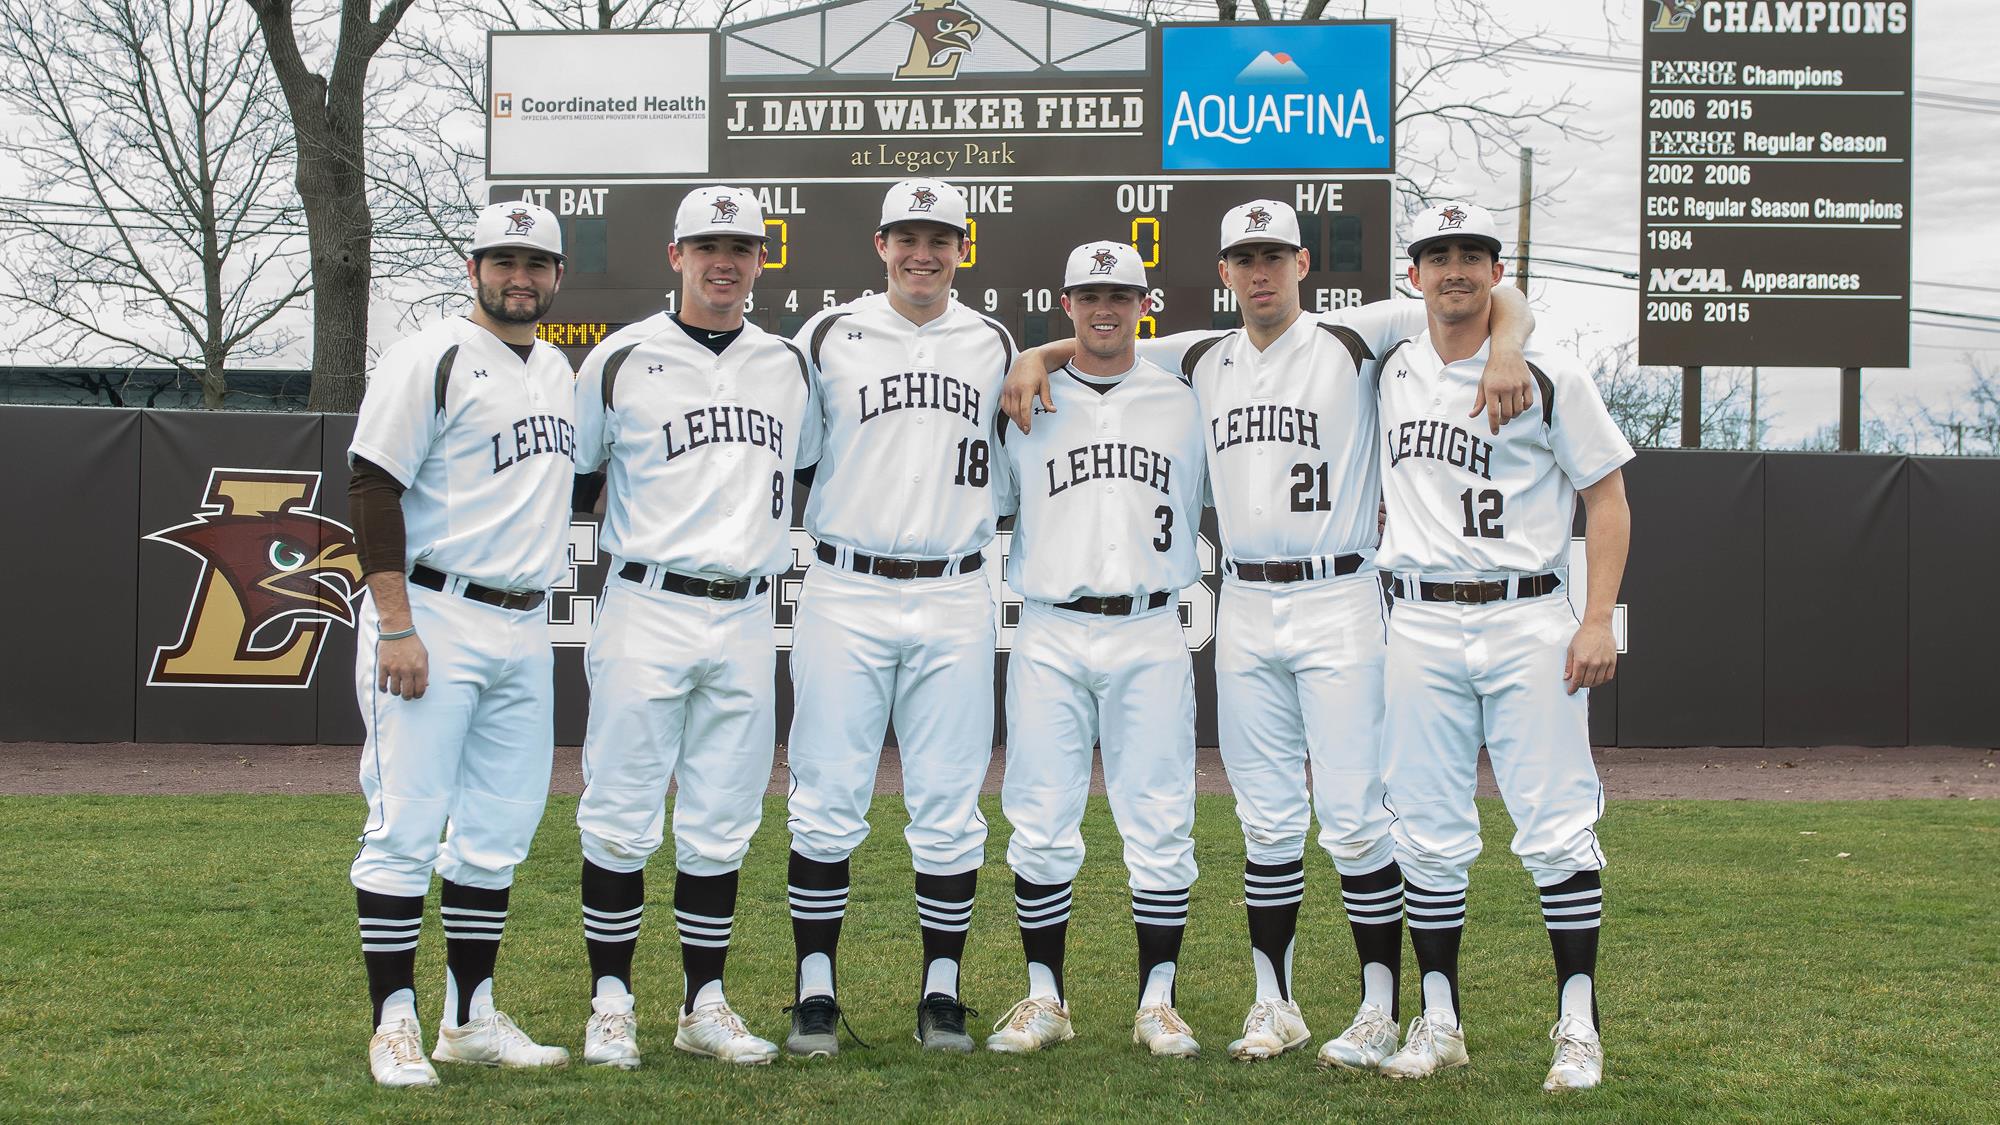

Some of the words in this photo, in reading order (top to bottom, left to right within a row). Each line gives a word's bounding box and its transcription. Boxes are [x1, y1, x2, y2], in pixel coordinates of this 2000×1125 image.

[1703, 1, 1907, 34] CHAMPIONS
[1650, 61, 1737, 74] PATRIOT
[1650, 73, 1737, 85] LEAGUE
[1742, 65, 1844, 90] Champions
[521, 96, 638, 113] Coordinated
[644, 95, 706, 112] Health
[727, 101, 754, 132] J.
[763, 100, 864, 131] DAVID
[874, 98, 1025, 130] WALKER
[1037, 97, 1143, 129] FIELD
[1168, 88, 1378, 146] AQUAFINA
[1649, 99, 1696, 120] 2006
[1706, 99, 1752, 120] 2015
[1649, 130, 1736, 143] PATRIOT
[1649, 142, 1736, 155] LEAGUE
[1743, 132, 1815, 155] Regular
[1820, 132, 1887, 153] Season
[851, 149, 872, 166] at
[878, 144, 959, 171] Legacy
[964, 142, 1015, 164] Park
[1648, 164, 1693, 185] 2002
[1705, 165, 1751, 185] 2006
[520, 188, 552, 208] AT
[559, 188, 609, 215] BAT
[756, 186, 806, 214] ALL
[1116, 183, 1174, 213] OUT
[1296, 183, 1343, 214] H/E
[1647, 196, 1679, 217] ECC
[1684, 197, 1746, 220] Regular
[1751, 197, 1809, 219] Season
[1814, 198, 1903, 223] Champions
[1131, 217, 1160, 268] 0
[1647, 230, 1692, 250] 1984
[1741, 269, 1860, 293] Appearances
[665, 289, 677, 313] 1
[785, 289, 799, 312] 4
[823, 289, 836, 309] 5
[984, 288, 998, 312] 9
[1022, 288, 1051, 312] 10
[1647, 302, 1694, 322] 2006
[1704, 302, 1750, 322] 2015
[858, 372, 981, 426] LEHIGH
[661, 405, 784, 462] LEHIGH
[1211, 405, 1321, 454] LEHIGH
[954, 436, 989, 488] 18
[1387, 418, 1493, 481] LEHIGH
[1046, 442, 1172, 498] LEHIGH
[771, 470, 785, 520] 8
[1290, 461, 1332, 513] 21
[1460, 487, 1504, 539] 12
[1152, 504, 1174, 553] 3
